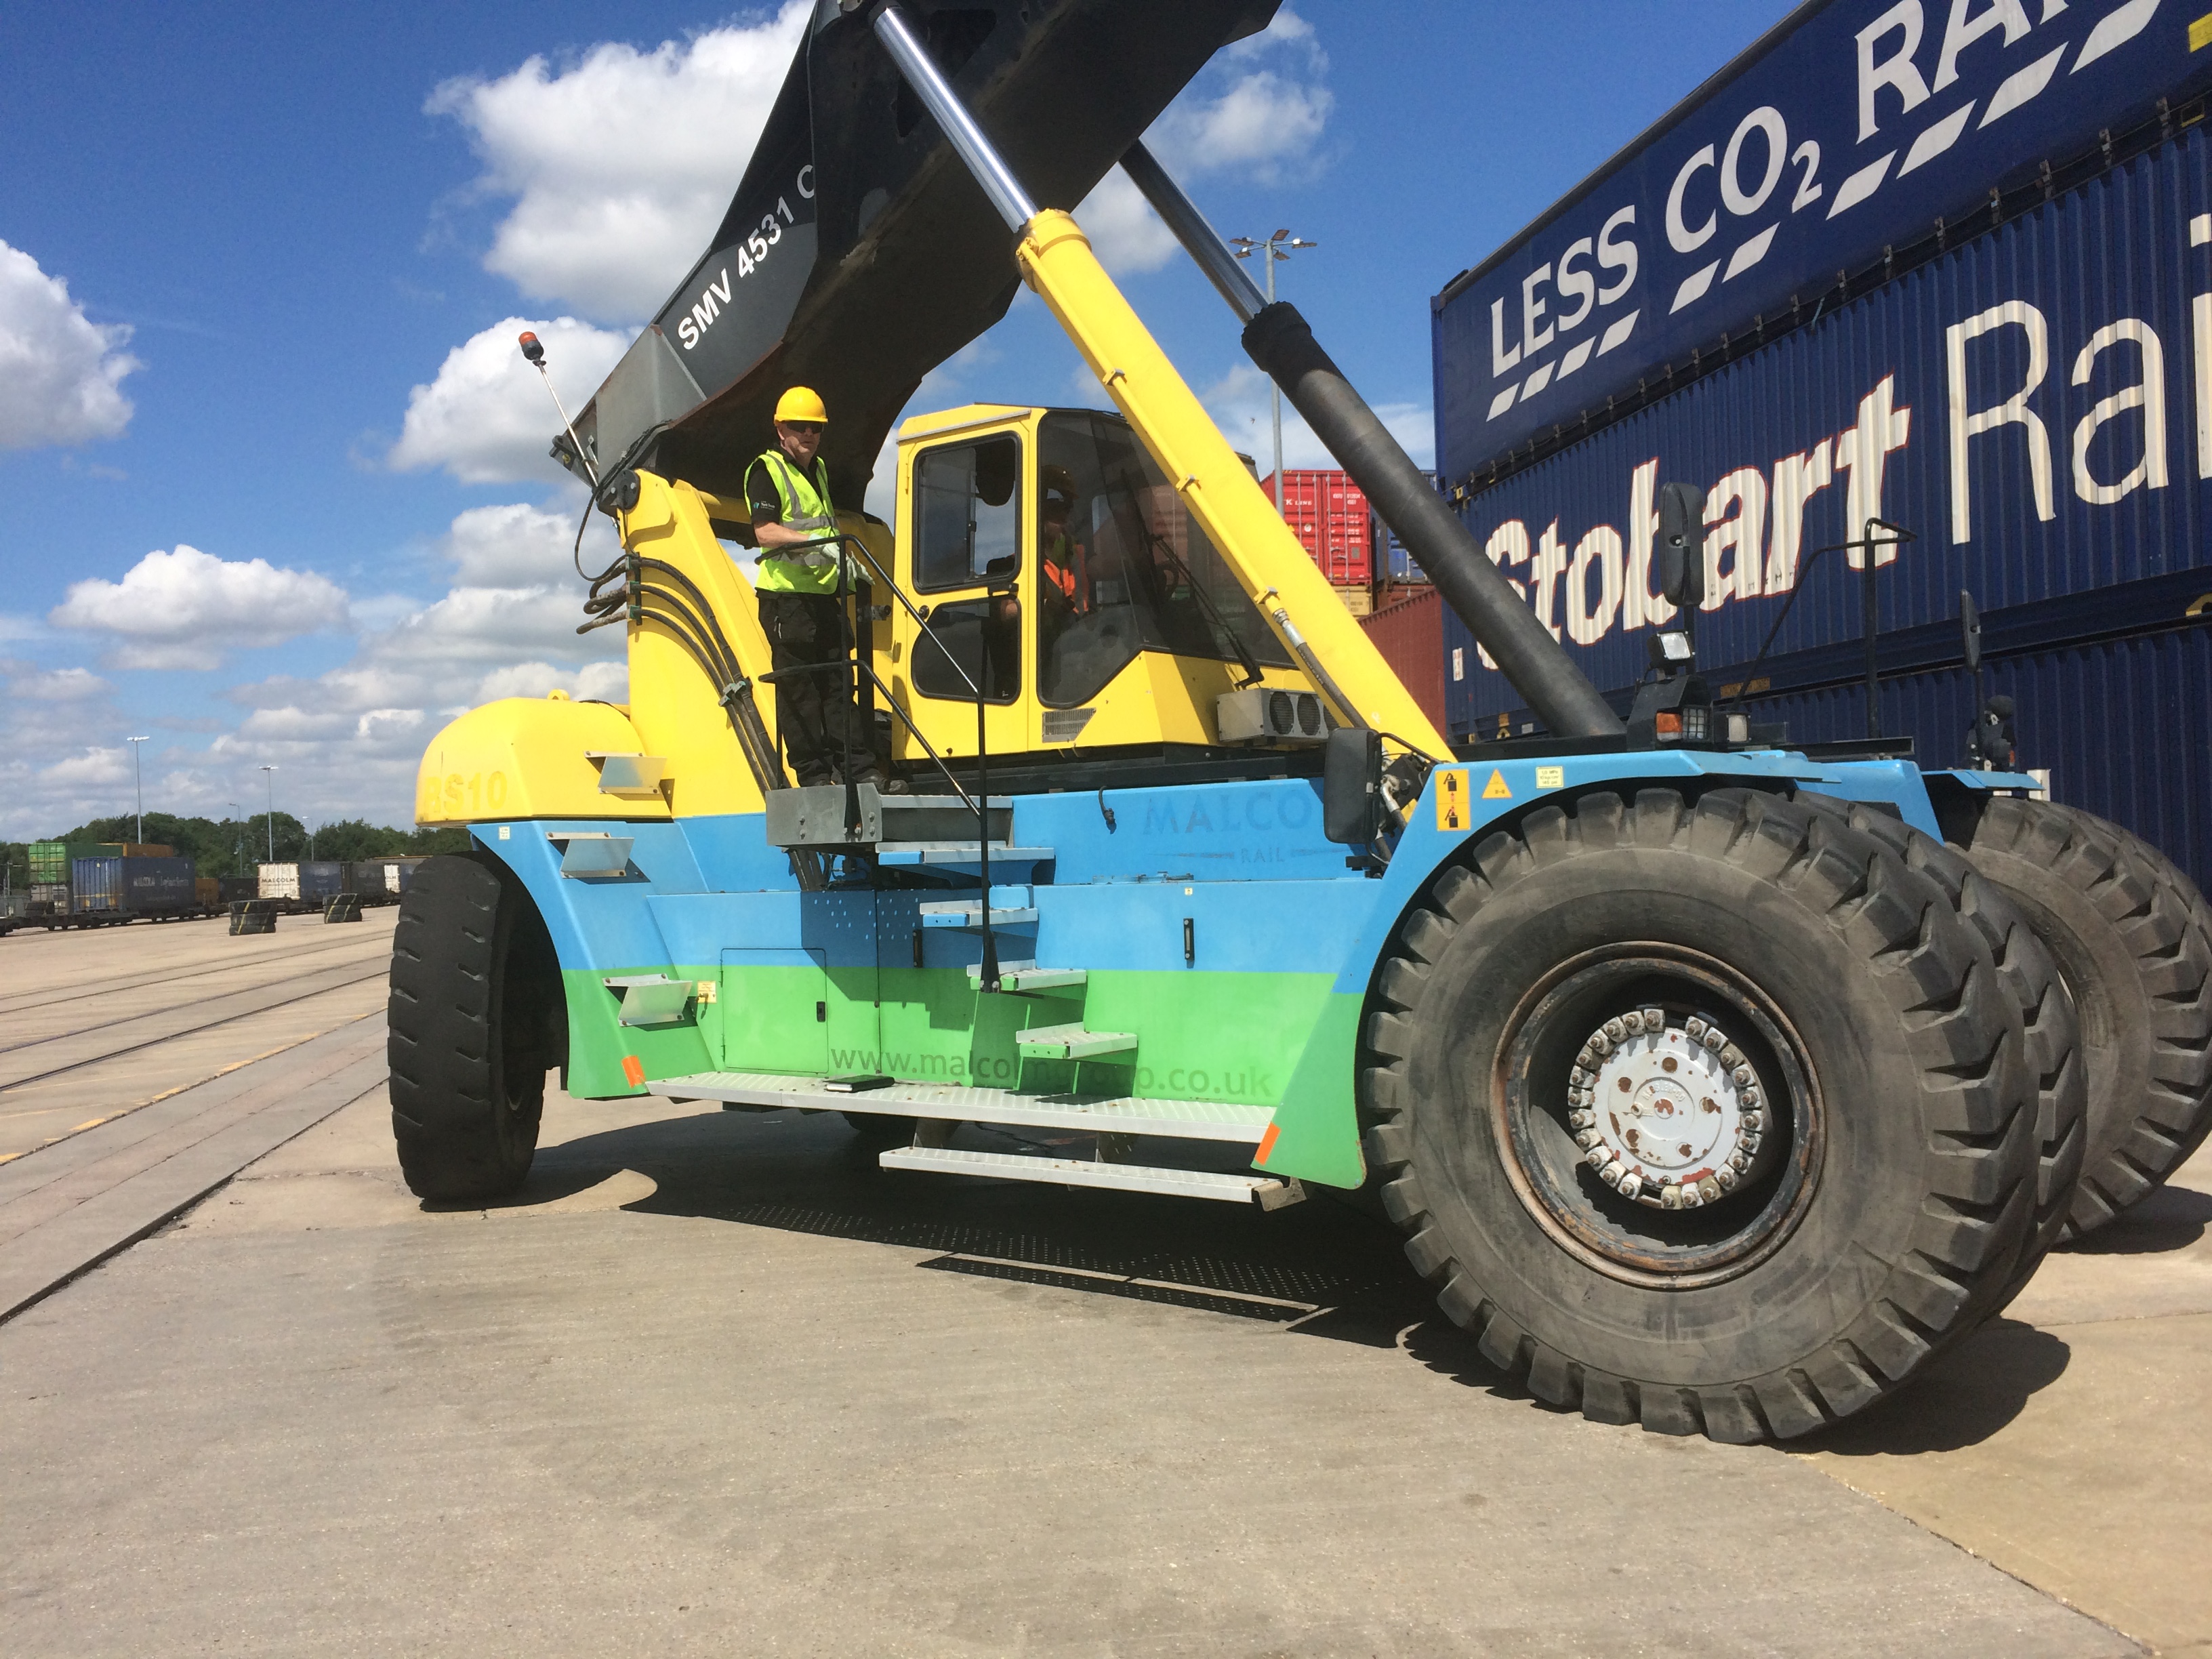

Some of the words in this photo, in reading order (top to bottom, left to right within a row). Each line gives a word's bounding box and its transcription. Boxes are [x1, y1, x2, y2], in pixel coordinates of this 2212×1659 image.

[1490, 205, 1639, 378] LESS
[1854, 0, 2070, 145] RA
[678, 268, 731, 350] SMV
[737, 196, 795, 279] 4531
[424, 771, 508, 814] RS10
[1143, 788, 1312, 835] MALCO
[1241, 847, 1285, 864] RAIL
